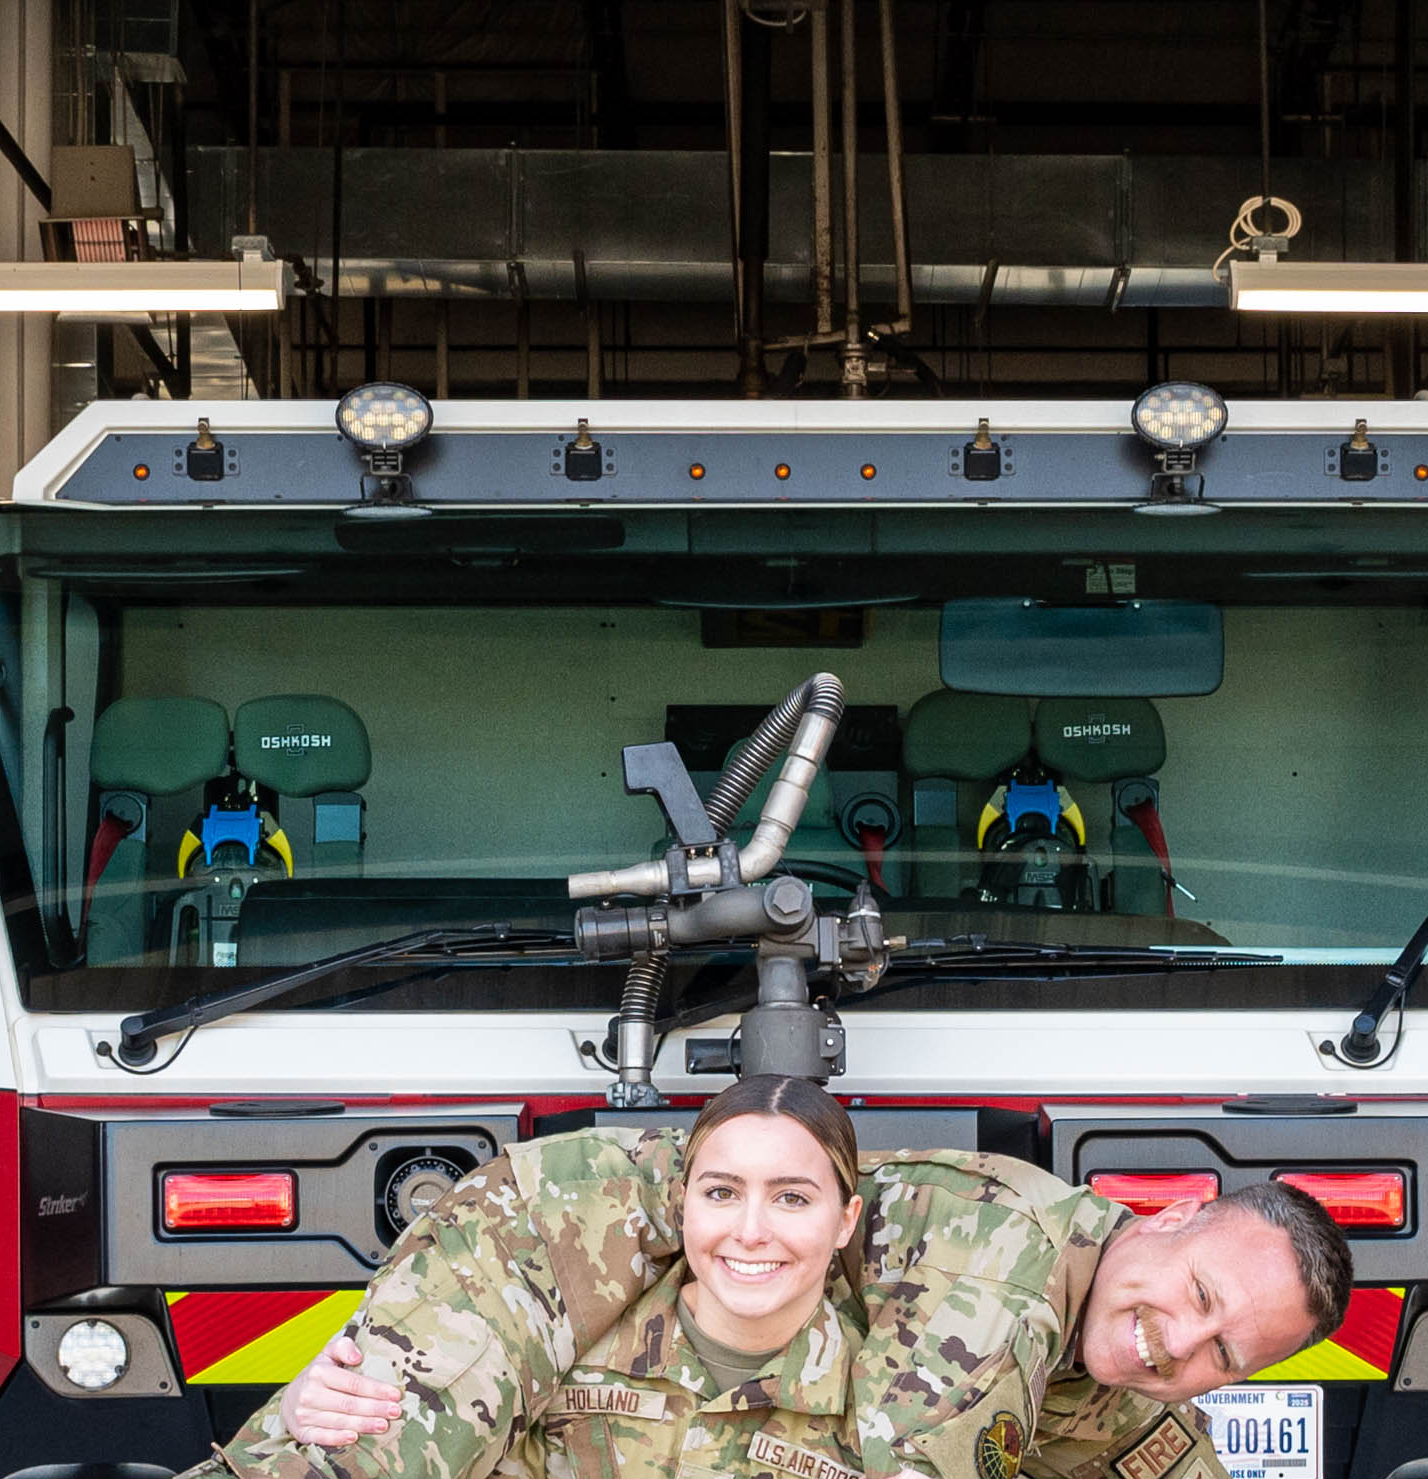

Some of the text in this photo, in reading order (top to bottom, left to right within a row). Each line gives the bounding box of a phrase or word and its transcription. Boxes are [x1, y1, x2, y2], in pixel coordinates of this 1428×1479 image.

[1063, 724, 1131, 738] OSHKOSH
[261, 735, 331, 749] OSHKOSH
[565, 1388, 640, 1413] HOLLAND
[1197, 1392, 1266, 1405] GOVERNMENT
[787, 1449, 816, 1477] AIR
[1230, 1470, 1267, 1479] USE ONLY
